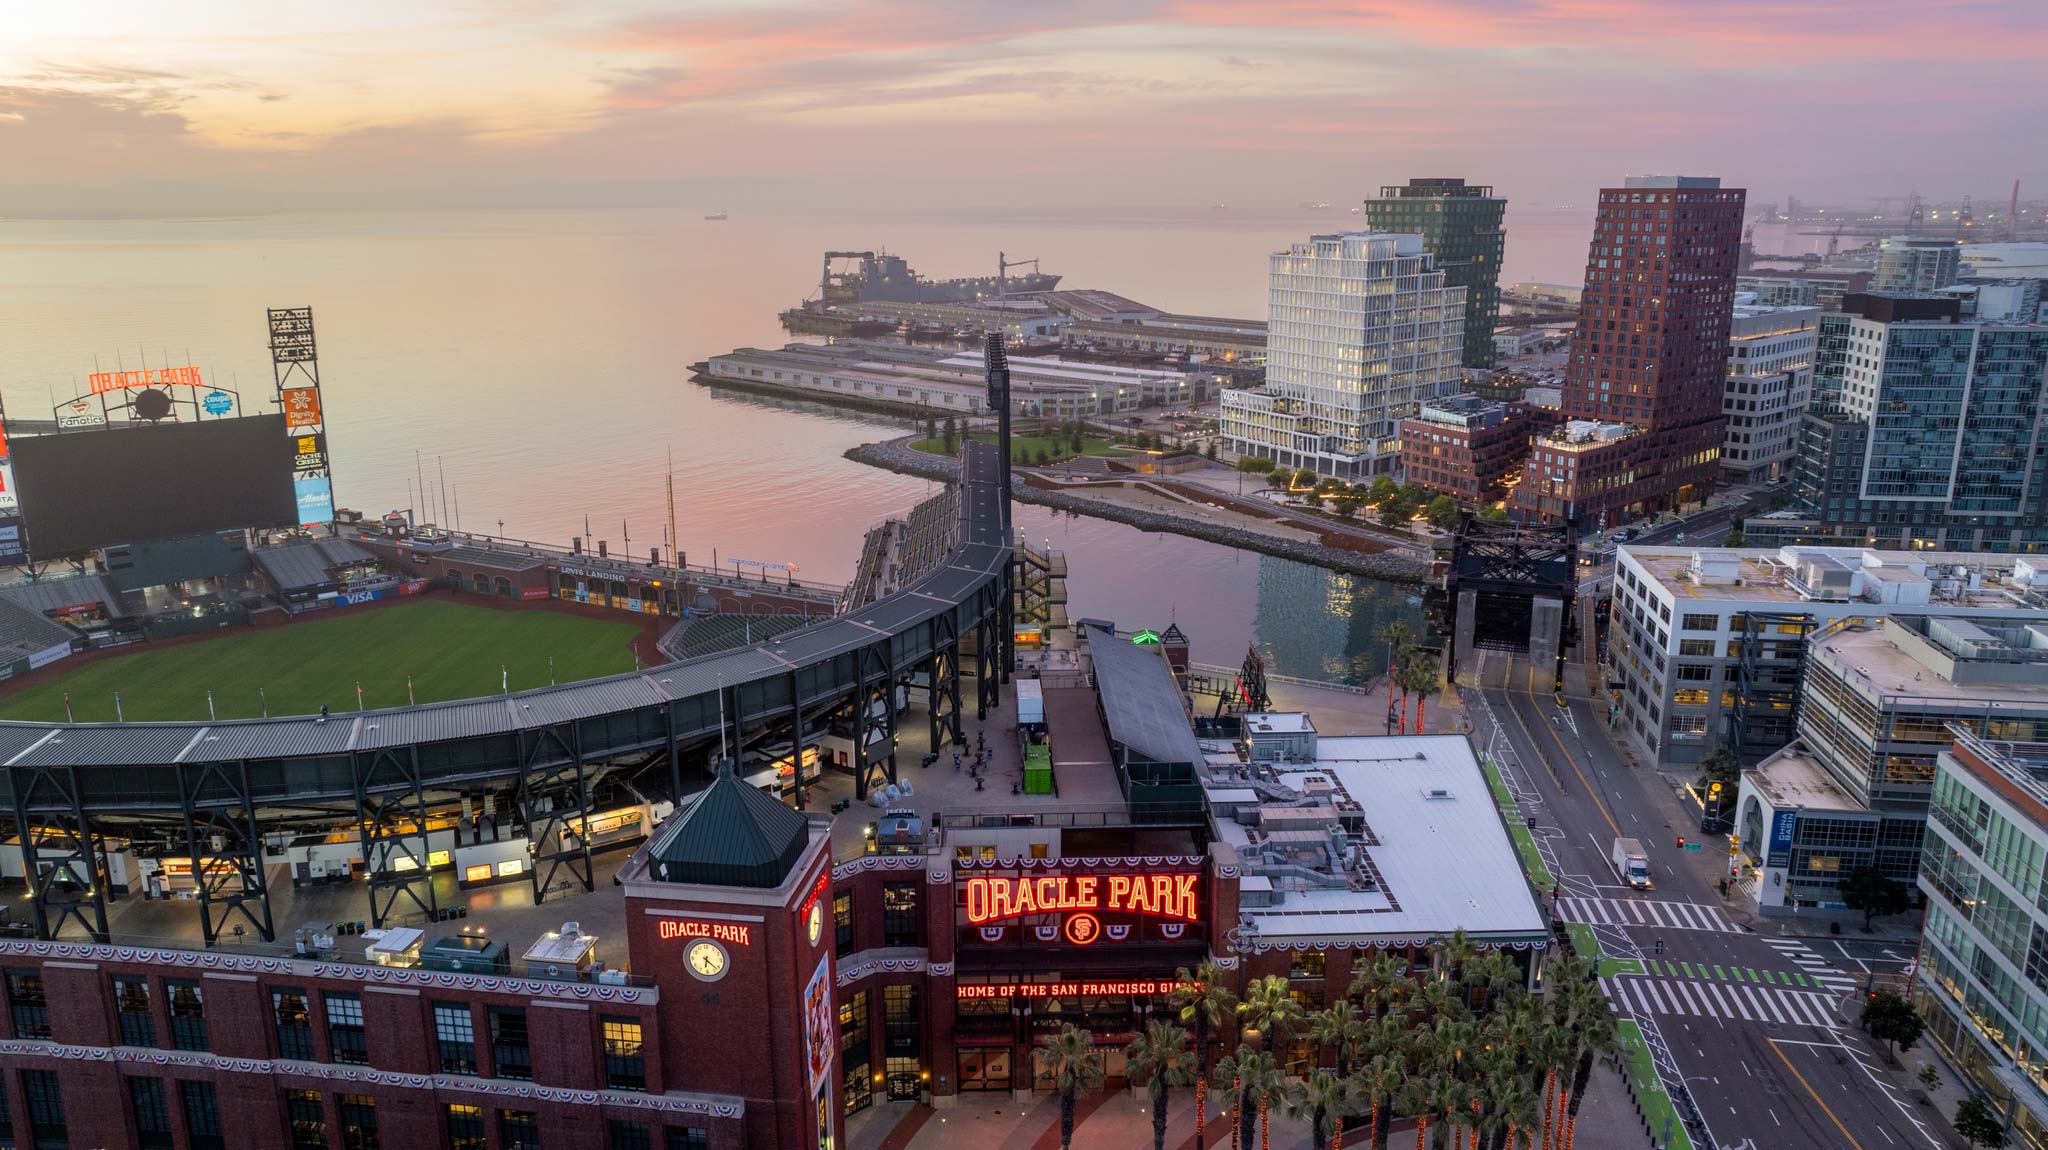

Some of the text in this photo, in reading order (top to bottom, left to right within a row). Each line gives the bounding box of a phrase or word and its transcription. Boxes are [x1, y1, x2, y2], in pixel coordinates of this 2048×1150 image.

[88, 366, 204, 395] ORACLE PARK
[59, 415, 105, 428] Fanatics
[290, 411, 315, 420] Dignity
[292, 418, 316, 426] Health
[586, 570, 625, 582] LANDING
[346, 591, 374, 604] VISA
[1778, 813, 1788, 841] CHINA
[1785, 813, 1794, 841] BASIN
[967, 875, 1198, 923] ORACLE PARK
[659, 921, 750, 946] ORACLE PARK
[958, 986, 995, 998] HOME
[1000, 986, 1016, 997] OF
[1020, 985, 1047, 997] THE
[1051, 984, 1077, 996] SAN
[1082, 983, 1155, 996] FRANCISCO
